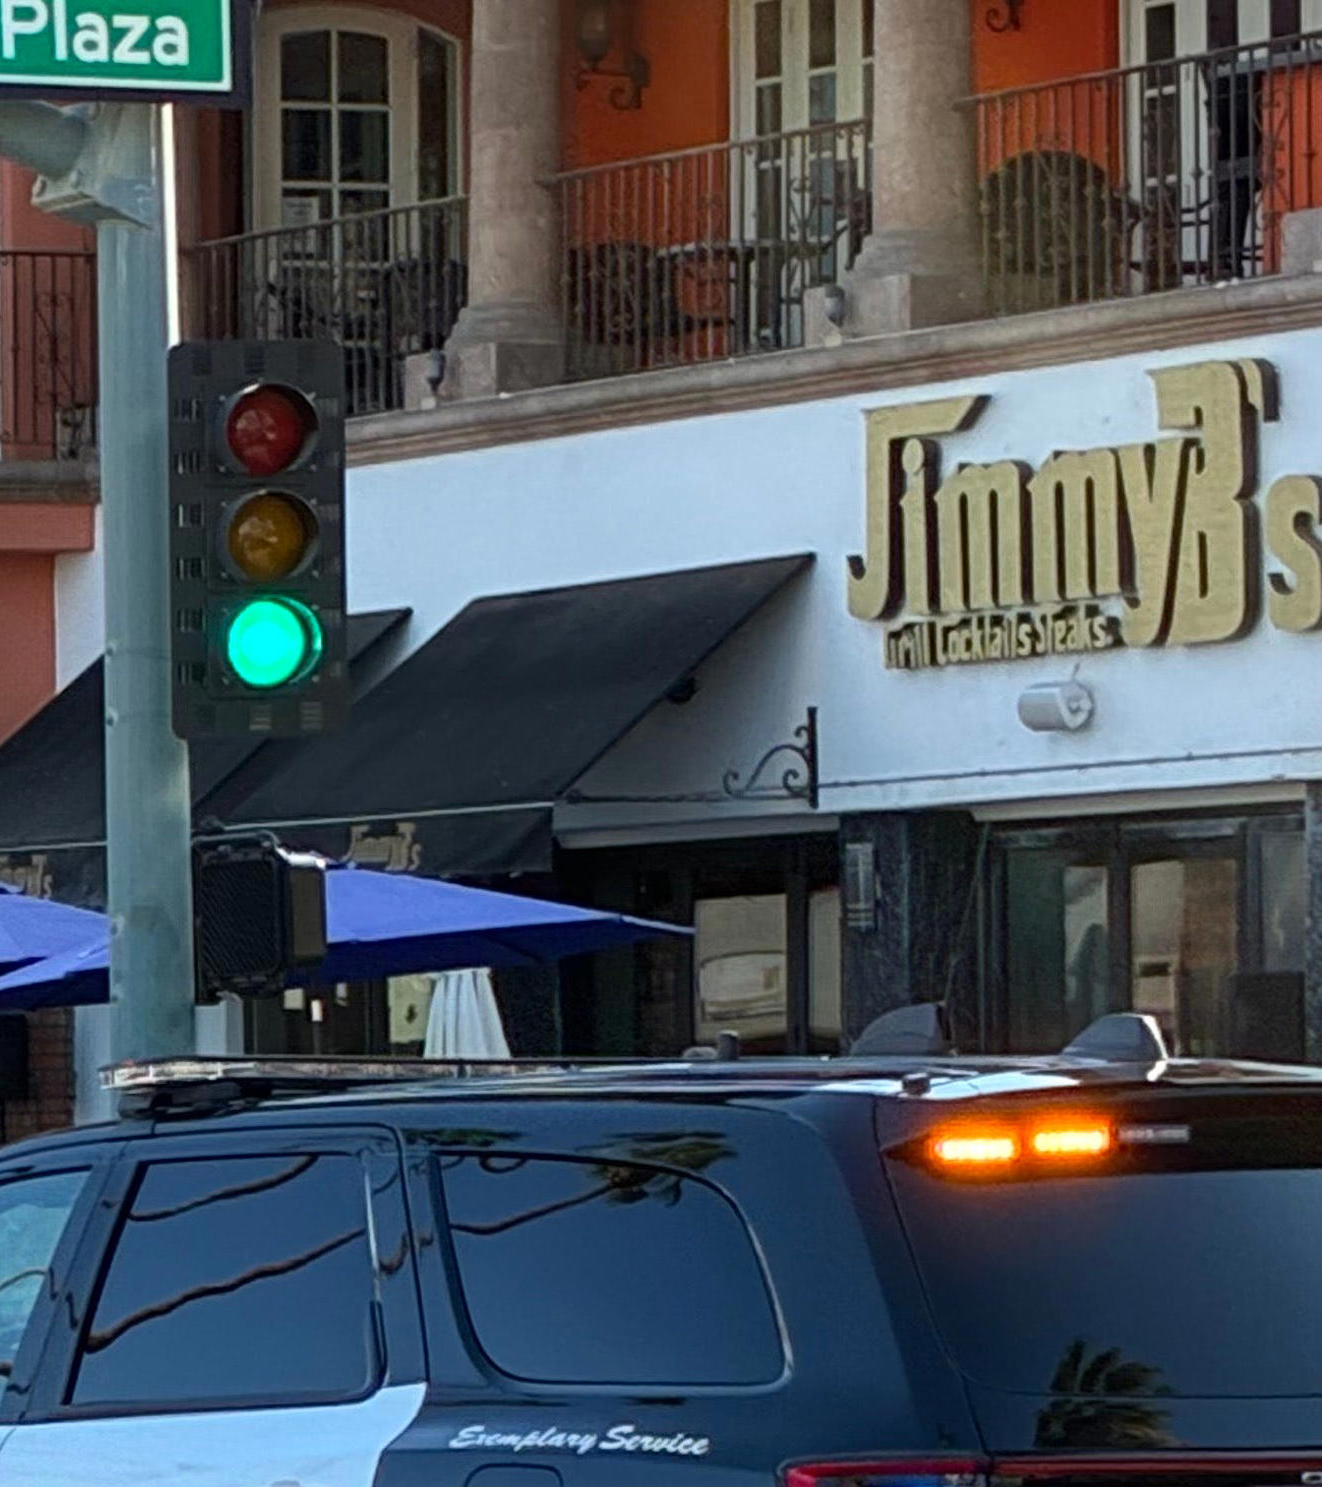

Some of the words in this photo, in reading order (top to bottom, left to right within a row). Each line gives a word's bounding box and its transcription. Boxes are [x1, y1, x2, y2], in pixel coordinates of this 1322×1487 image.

[2, 0, 189, 66] Plaza
[449, 1424, 598, 1455] Exemplary
[599, 1424, 709, 1455] Service
